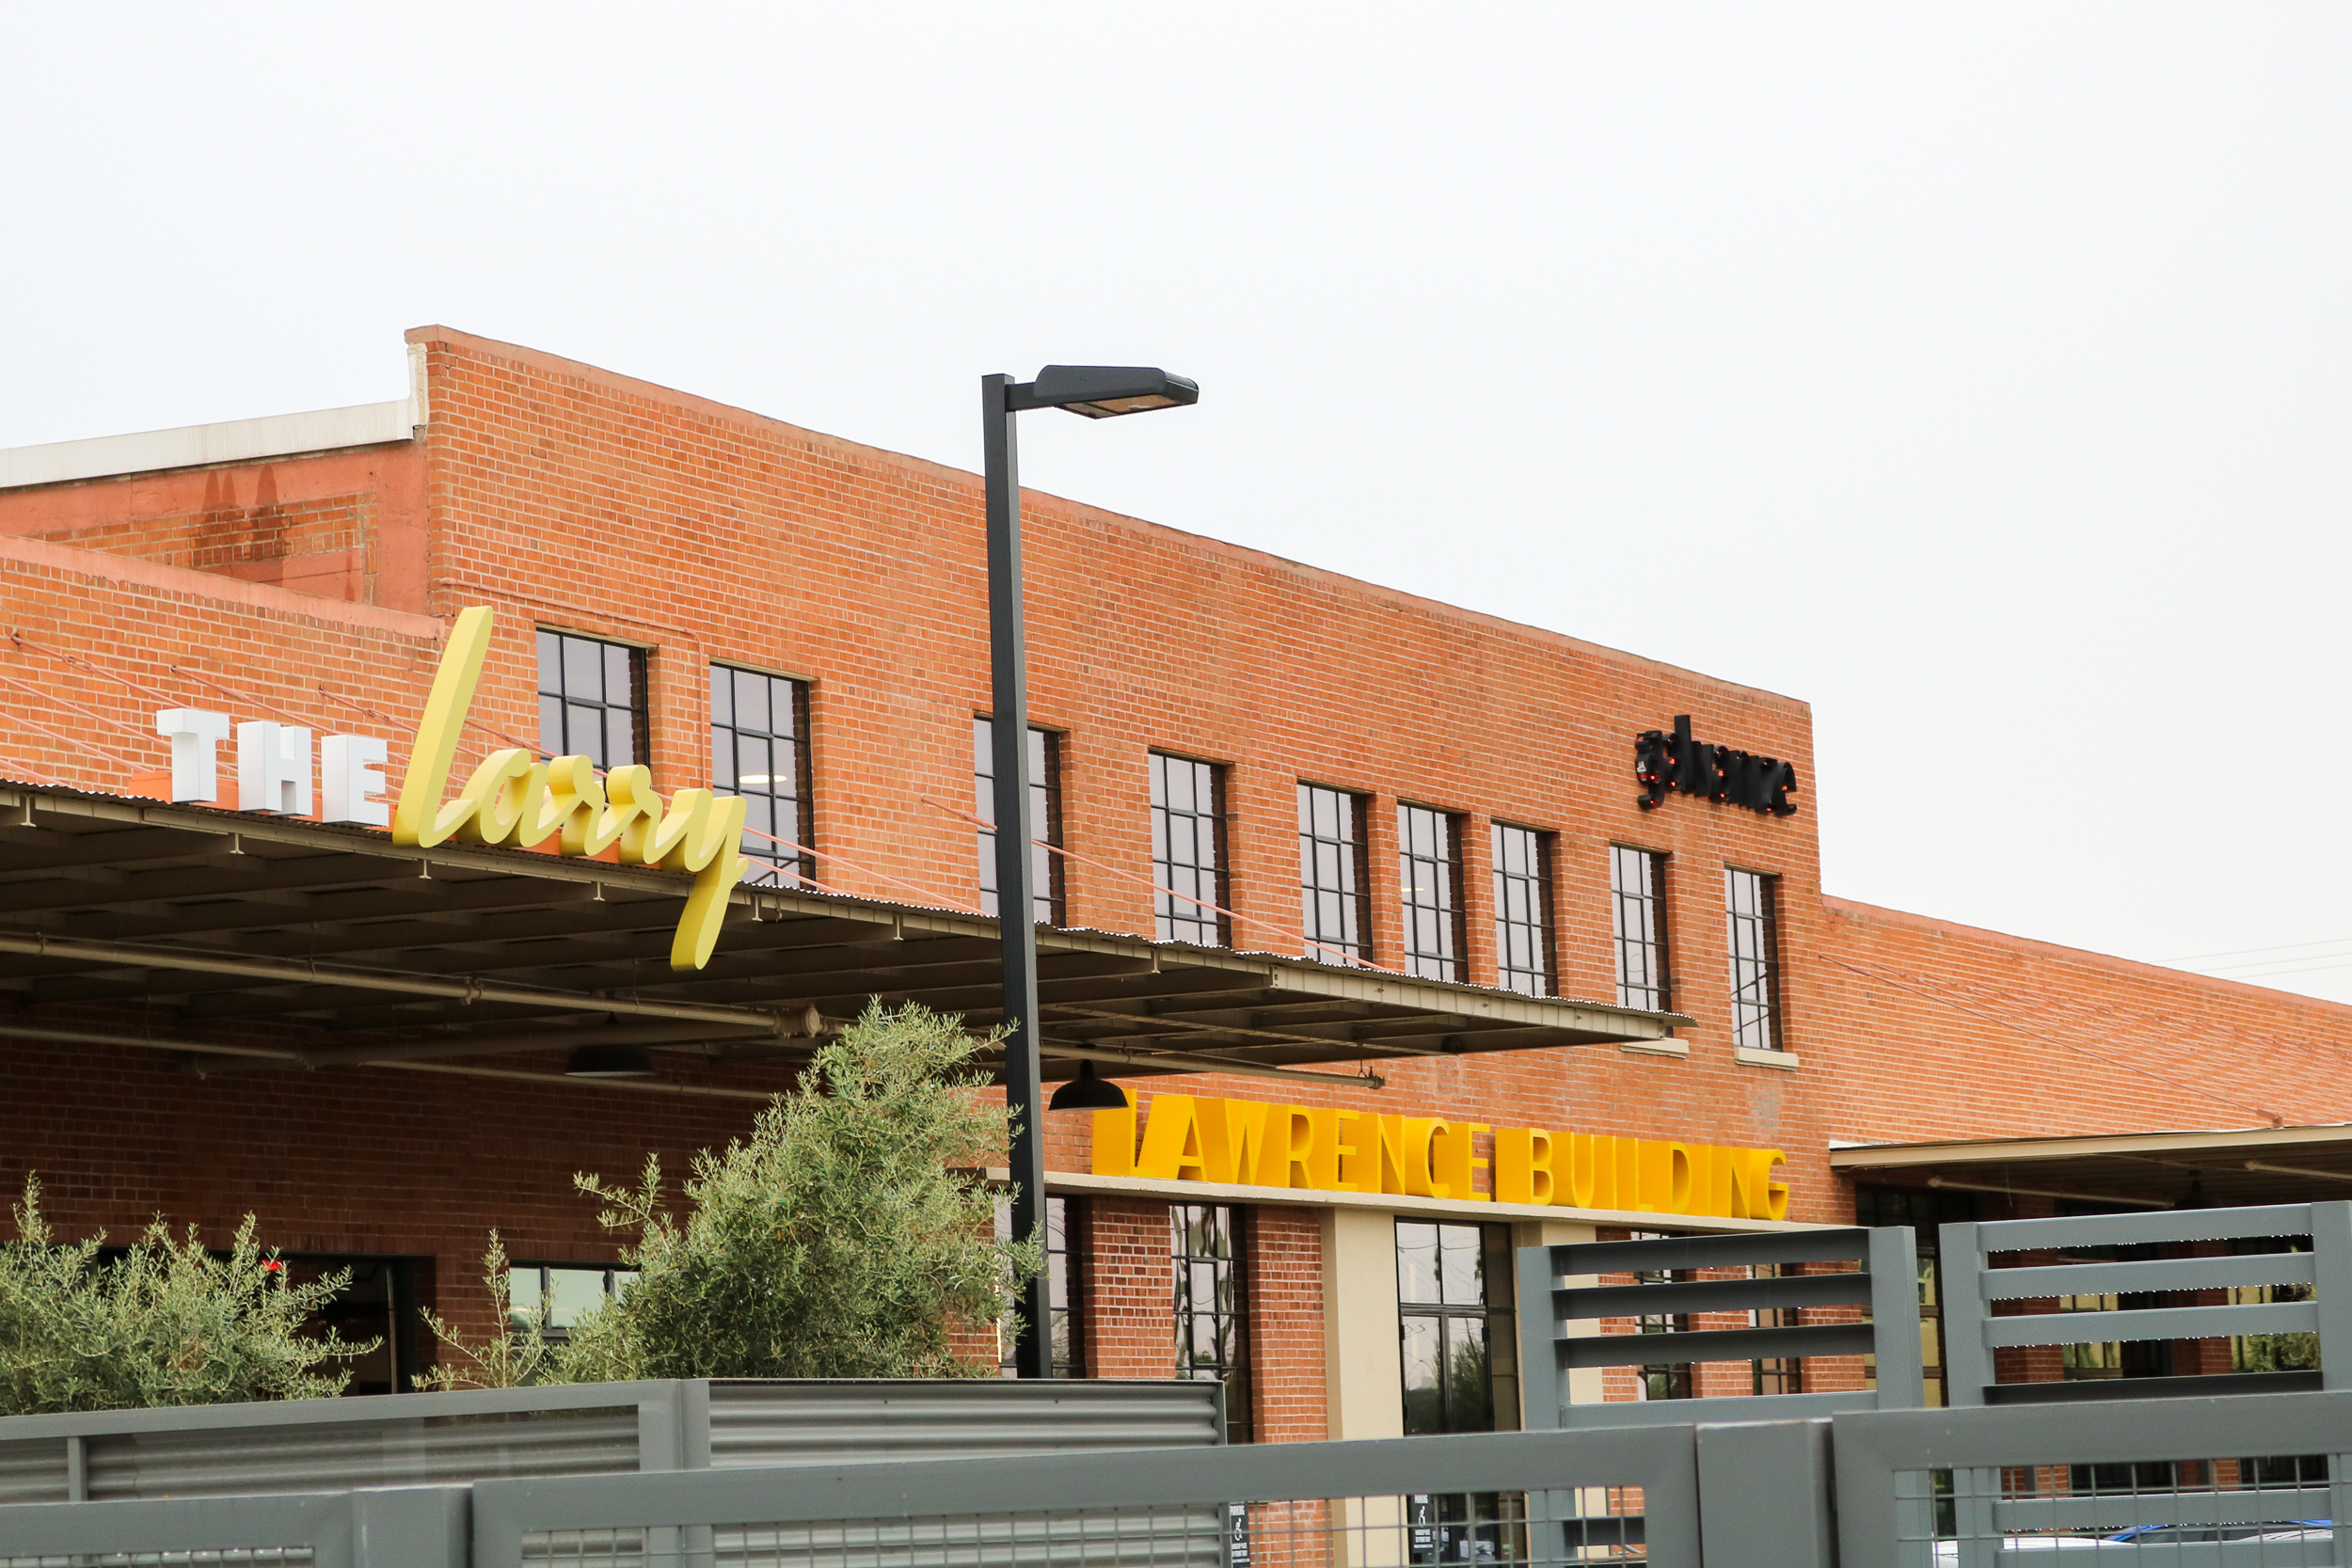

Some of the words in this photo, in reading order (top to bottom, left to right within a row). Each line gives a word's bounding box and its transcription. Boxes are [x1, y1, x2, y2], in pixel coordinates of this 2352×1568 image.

[156, 707, 389, 826] THE
[1092, 1088, 1491, 1202] LAWRENCE
[1496, 1128, 1787, 1222] BUILDING
